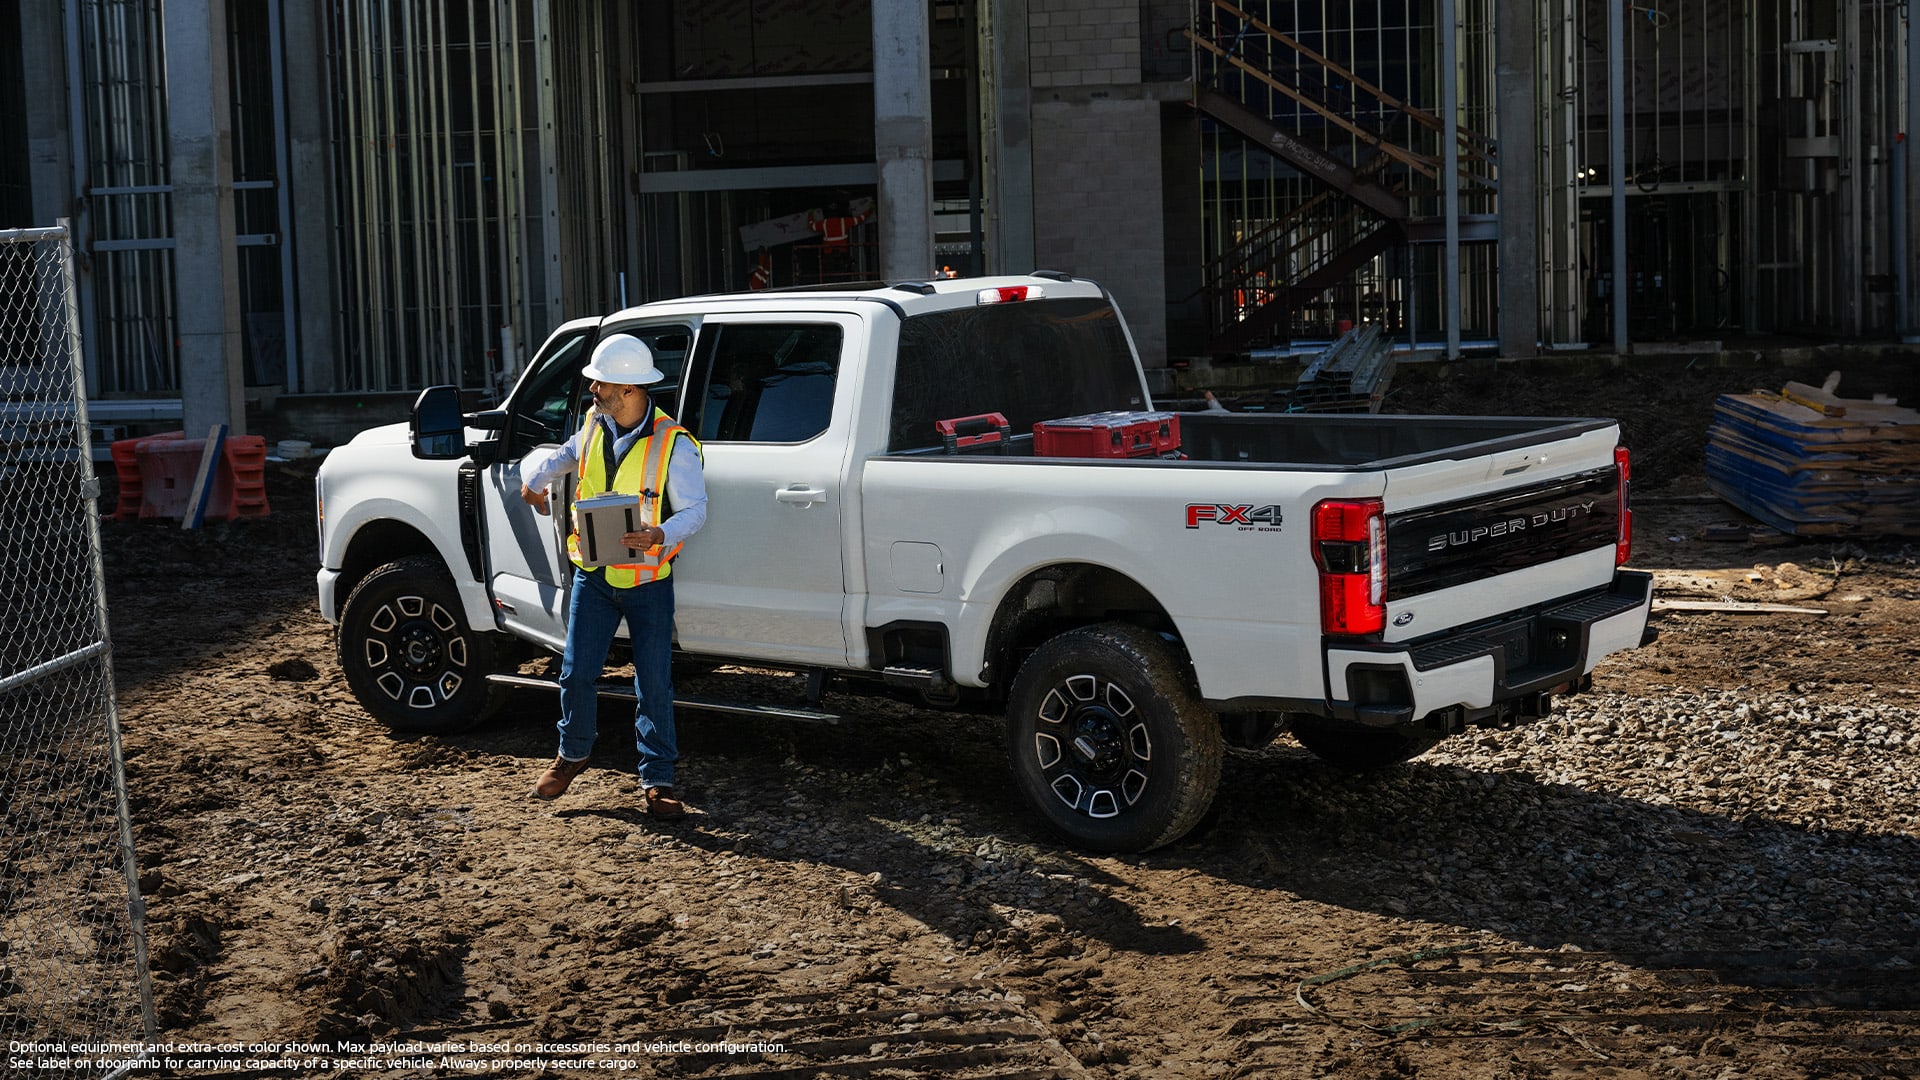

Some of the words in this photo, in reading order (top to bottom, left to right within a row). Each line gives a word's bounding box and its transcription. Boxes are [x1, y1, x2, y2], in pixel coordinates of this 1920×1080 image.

[1185, 503, 1282, 529] FX4
[1428, 518, 1526, 551] SUPER
[1532, 501, 1594, 528] DUTY
